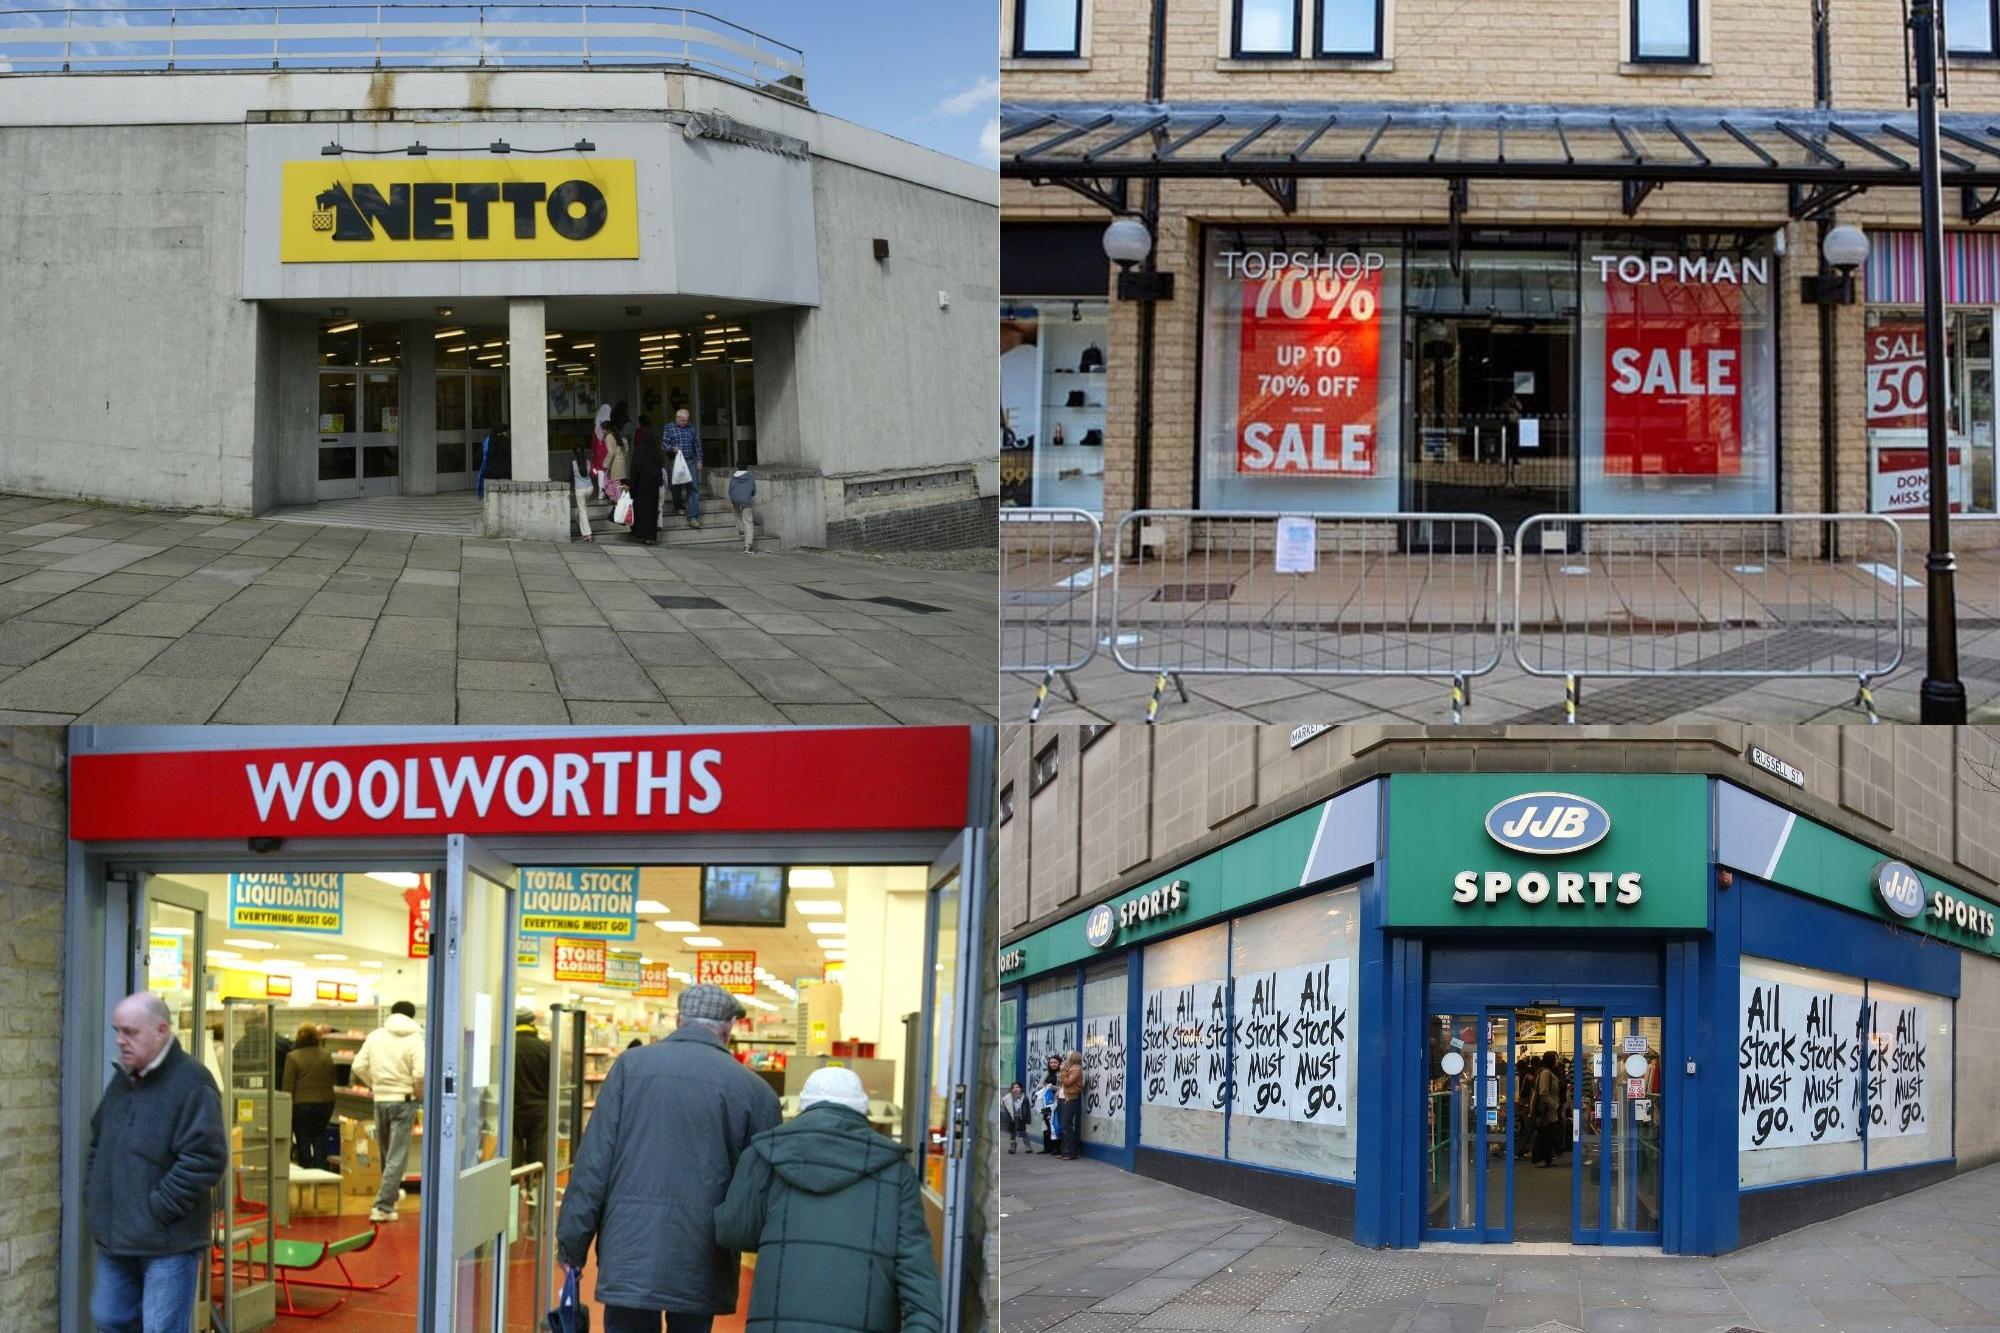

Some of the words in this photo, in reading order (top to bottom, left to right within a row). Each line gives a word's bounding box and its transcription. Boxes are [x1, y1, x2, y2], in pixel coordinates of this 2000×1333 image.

[334, 179, 608, 241] NETTO
[1219, 252, 1385, 280] TOPSHOP
[1592, 256, 1768, 284] TOPMAN
[1255, 266, 1375, 321] 70%
[1277, 346, 1306, 367] UP
[1314, 346, 1341, 367] TO
[1874, 333, 1925, 361] SAL
[1258, 375, 1310, 397] 70%
[1317, 376, 1360, 397] OFF
[1611, 347, 1736, 395] SALE
[1243, 422, 1371, 472] SALE
[1897, 473, 1930, 488] DON
[1888, 491, 1920, 506] MISS
[1756, 750, 1788, 777] RUSSELL
[1791, 769, 1800, 784] ST
[245, 748, 723, 823] WOOLWORTHS
[1503, 806, 1590, 838] JJB
[236, 883, 340, 909] LIQUIDATION
[525, 871, 574, 891] TOTAL
[580, 872, 633, 893] STOCK
[1453, 870, 1643, 904] SPORTS
[238, 910, 294, 924] EVERYTHING
[296, 913, 320, 925] MUST
[321, 915, 337, 927] GO!
[524, 890, 633, 914] LIQUIDATION
[1089, 914, 1110, 939] JJB
[1119, 880, 1182, 928] SPORTS
[1886, 871, 1919, 906] JJB
[1934, 891, 1994, 937] SPORTS
[524, 917, 582, 930] EVERYTHING
[583, 920, 608, 931] MUST
[611, 921, 628, 932] GO!
[556, 946, 604, 962] STORE
[556, 960, 604, 973] CLOSING
[701, 960, 753, 974] STORE
[641, 969, 667, 981] TORE
[701, 974, 753, 985] CLOSING
[1300, 963, 1330, 1015] All
[1146, 989, 1163, 1026] All
[1176, 985, 1195, 1024] All
[1251, 971, 1277, 1018] All
[1747, 984, 1780, 1033] All
[1806, 993, 1834, 1038] All
[1896, 1006, 1916, 1045] All
[1295, 1046, 1341, 1090] Must
[1147, 1077, 1168, 1102] go.
[1178, 1078, 1201, 1106] go.
[1253, 1081, 1287, 1114] go.
[1303, 1083, 1343, 1119] go.
[1741, 1069, 1792, 1115] Must
[1802, 1071, 1844, 1114] Must
[1751, 1106, 1794, 1146] go.
[1810, 1104, 1845, 1142] go.
[1898, 1102, 1925, 1133] go.
